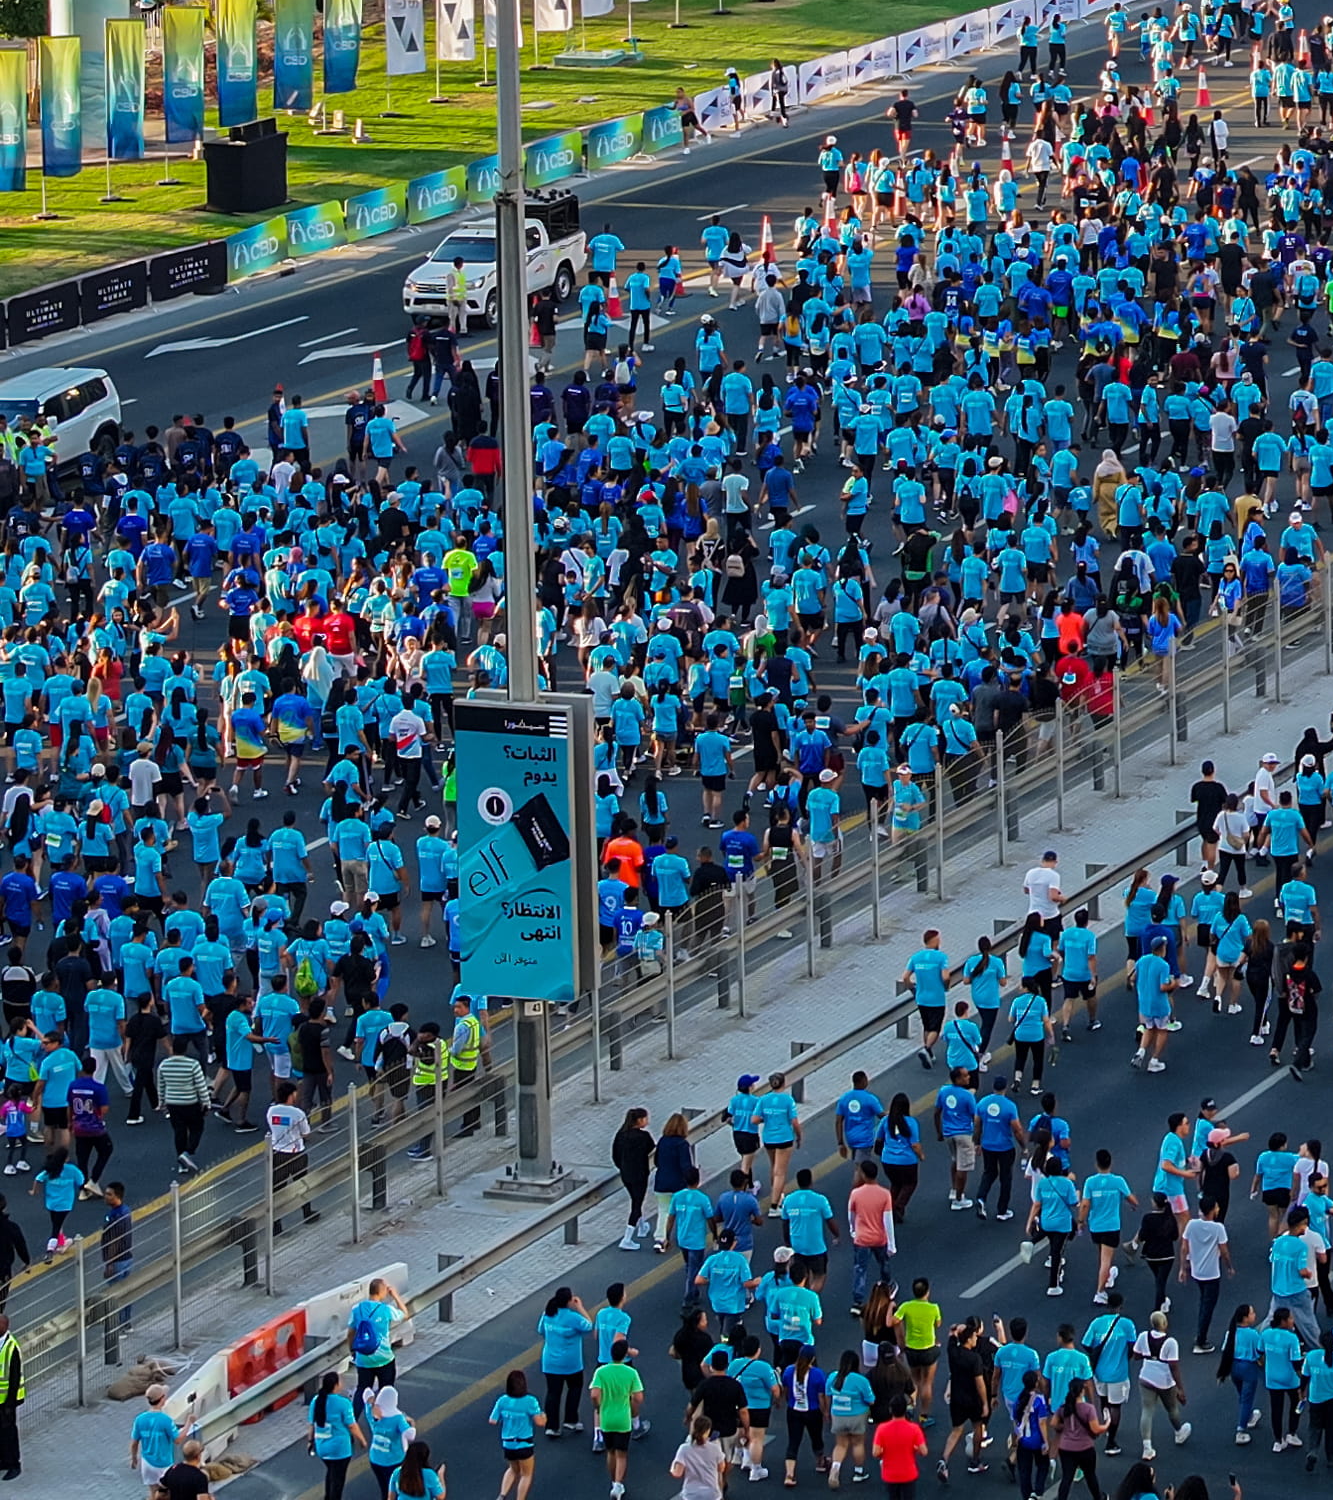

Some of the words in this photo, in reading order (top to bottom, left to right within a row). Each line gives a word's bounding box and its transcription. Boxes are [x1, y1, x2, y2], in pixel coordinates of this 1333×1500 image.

[610, 132, 635, 153] CBD
[549, 148, 575, 169] CBD
[432, 185, 458, 205] CBD
[370, 202, 397, 224] CBD
[306, 221, 335, 242] CBD
[251, 236, 279, 260] CBD
[169, 258, 209, 276] ULTIMATE
[98, 279, 132, 296] ULTIMATE
[26, 301, 63, 318] ULTIMATE
[503, 745, 557, 766] الثبات؟
[523, 770, 558, 787] يدوم
[468, 839, 509, 897] elf
[501, 901, 561, 920] الانتظار؟
[520, 925, 562, 941] انتهى
[621, 920, 633, 935] 10
[532, 1002, 542, 1013] 43
[72, 1098, 94, 1114] 04
